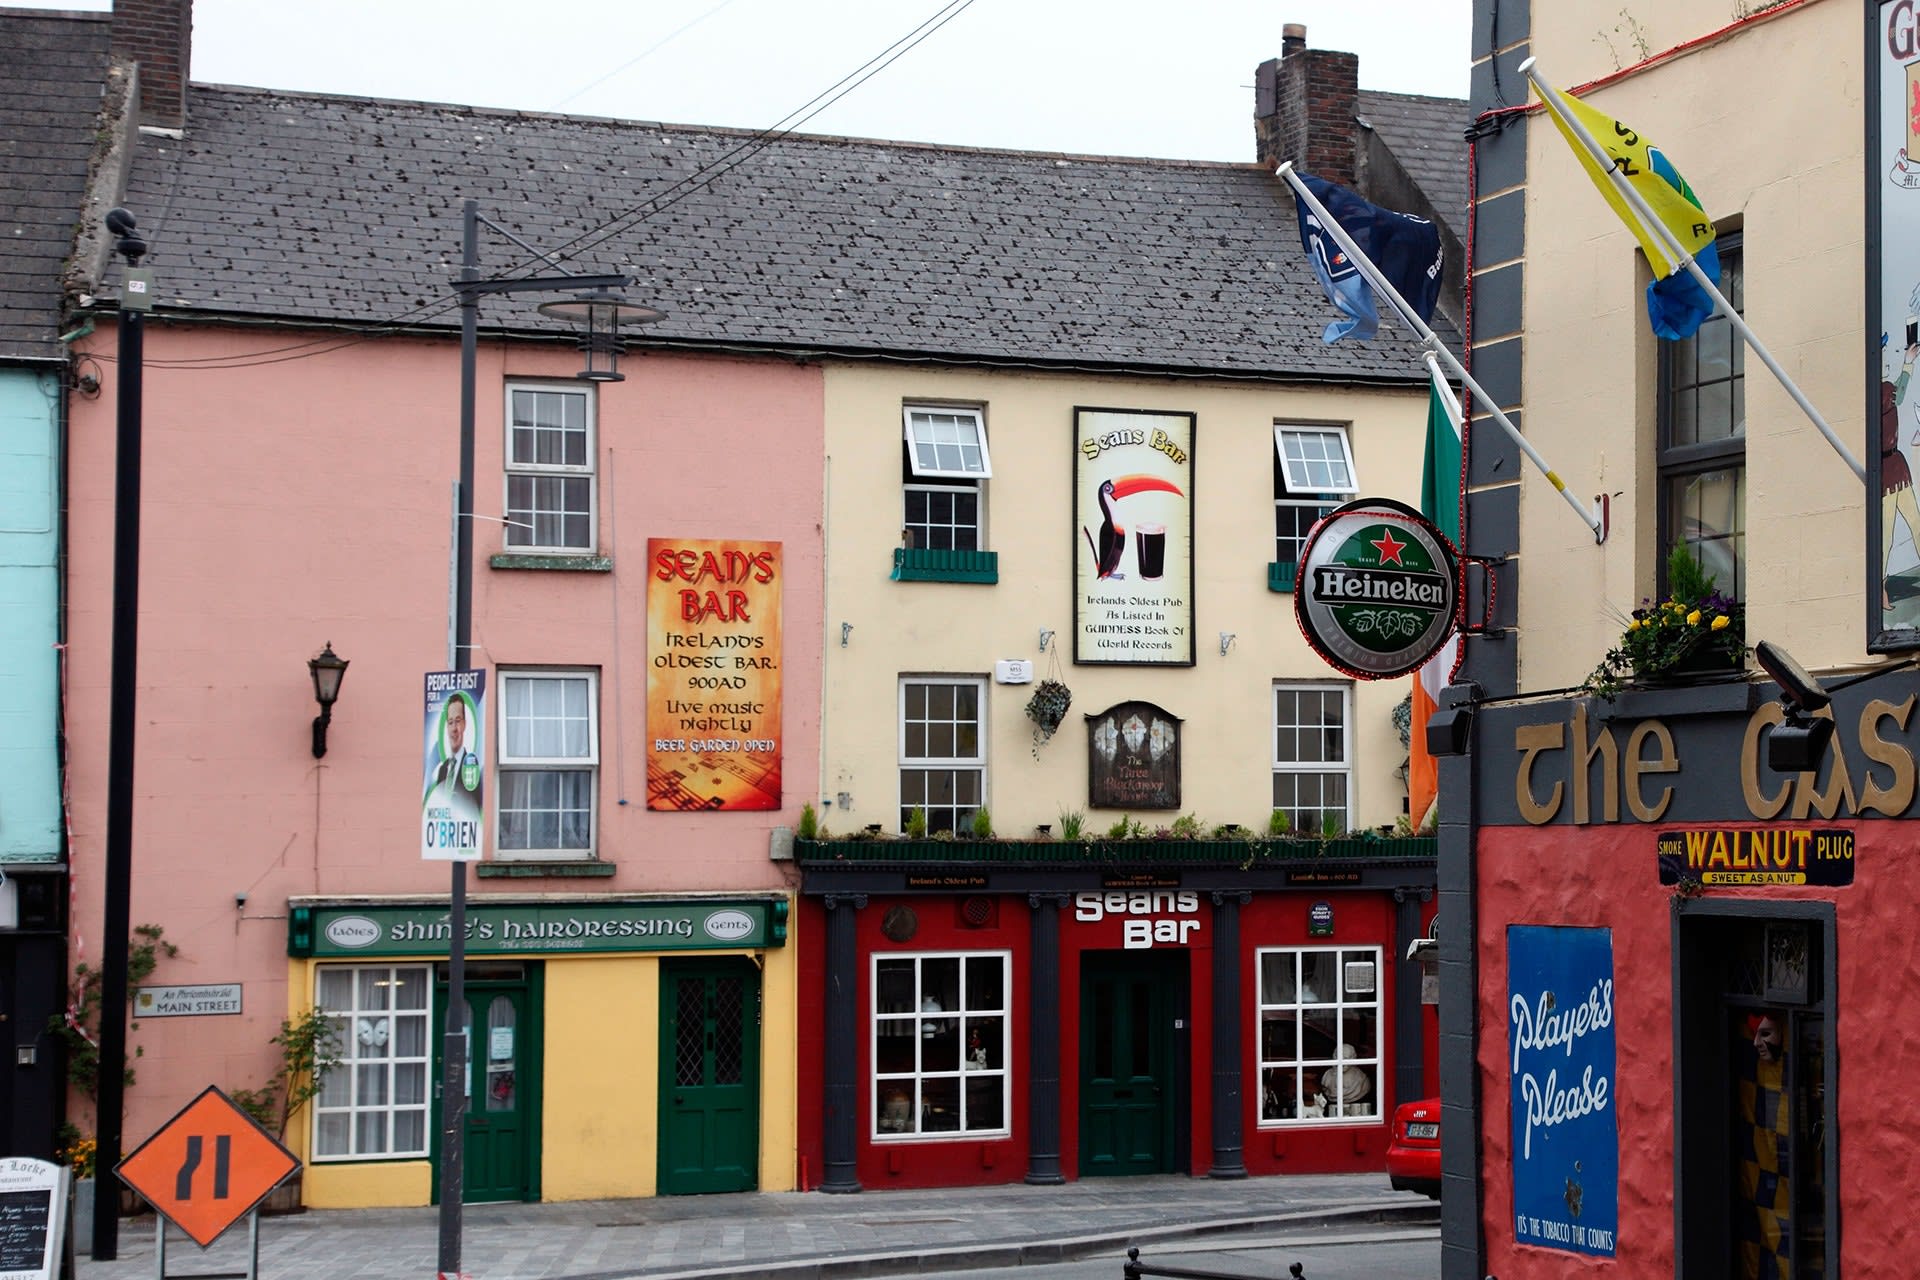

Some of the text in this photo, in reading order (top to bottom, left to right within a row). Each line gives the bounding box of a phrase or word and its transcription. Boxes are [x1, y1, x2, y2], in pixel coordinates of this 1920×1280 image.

[1082, 427, 1187, 464] Seans Bar
[656, 549, 774, 585] SEAN'S
[1320, 571, 1443, 604] Heineken
[678, 590, 751, 625] BAR
[1087, 595, 1183, 606] Irelands Oldest Pub
[1106, 610, 1165, 620] As Listed In
[666, 632, 764, 649] IRELAND'S
[1085, 624, 1184, 635] GUINNESS Book Of
[1097, 639, 1172, 649] World Records
[655, 653, 777, 670] OLDEST BAR.
[427, 672, 479, 691] PEOPLE FIRST
[688, 676, 747, 691] 900AD
[655, 739, 775, 754] BEER GARDEN OPEN
[1515, 702, 1681, 825] The
[427, 808, 451, 819] MICHAEL
[427, 821, 477, 848] O'BRIEN
[1658, 830, 1852, 869] SMOKE WALNUT PLUG
[1711, 873, 1796, 883] SWEET AS A NUT
[1076, 891, 1199, 921] Seans
[1124, 919, 1201, 949] Bar
[157, 1001, 237, 1013] MAIN STREET
[1511, 978, 1613, 1074] Player's
[1522, 1064, 1608, 1160] Please
[1517, 1213, 1613, 1251] IT'S THE TOBACCO THAT COUNTS
